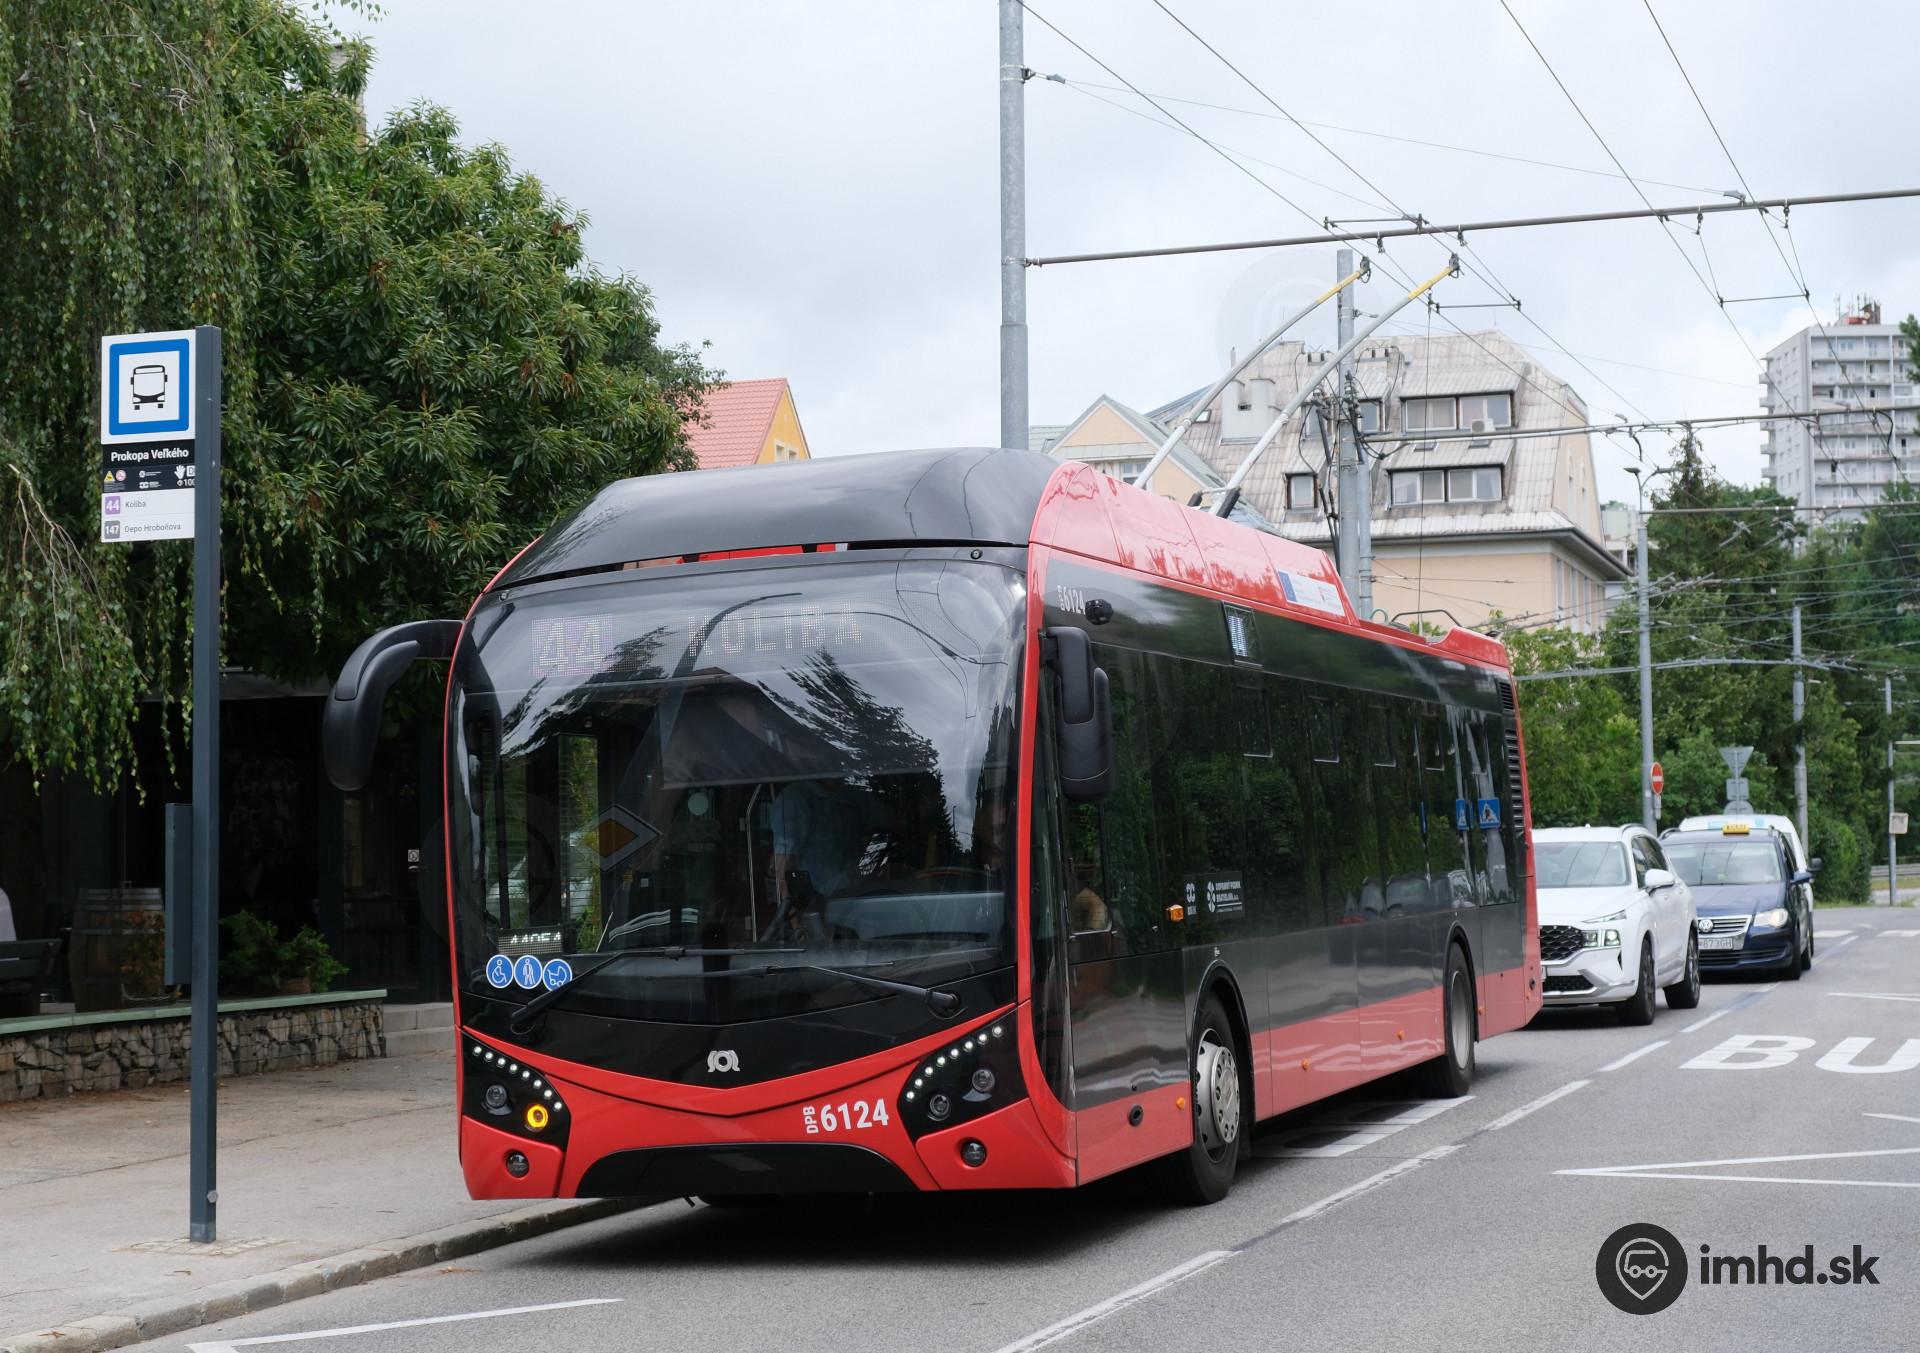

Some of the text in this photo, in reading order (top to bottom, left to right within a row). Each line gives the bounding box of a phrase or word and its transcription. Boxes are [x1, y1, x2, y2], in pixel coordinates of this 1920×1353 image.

[111, 447, 189, 462] Prokopa Veľkého
[106, 500, 147, 511] 44 Koliba
[105, 525, 119, 535] 147
[124, 525, 143, 534] Depo
[1062, 586, 1086, 615] 6124
[539, 601, 864, 672] 44 KOLIBA
[803, 1098, 889, 1134] DPB 6124
